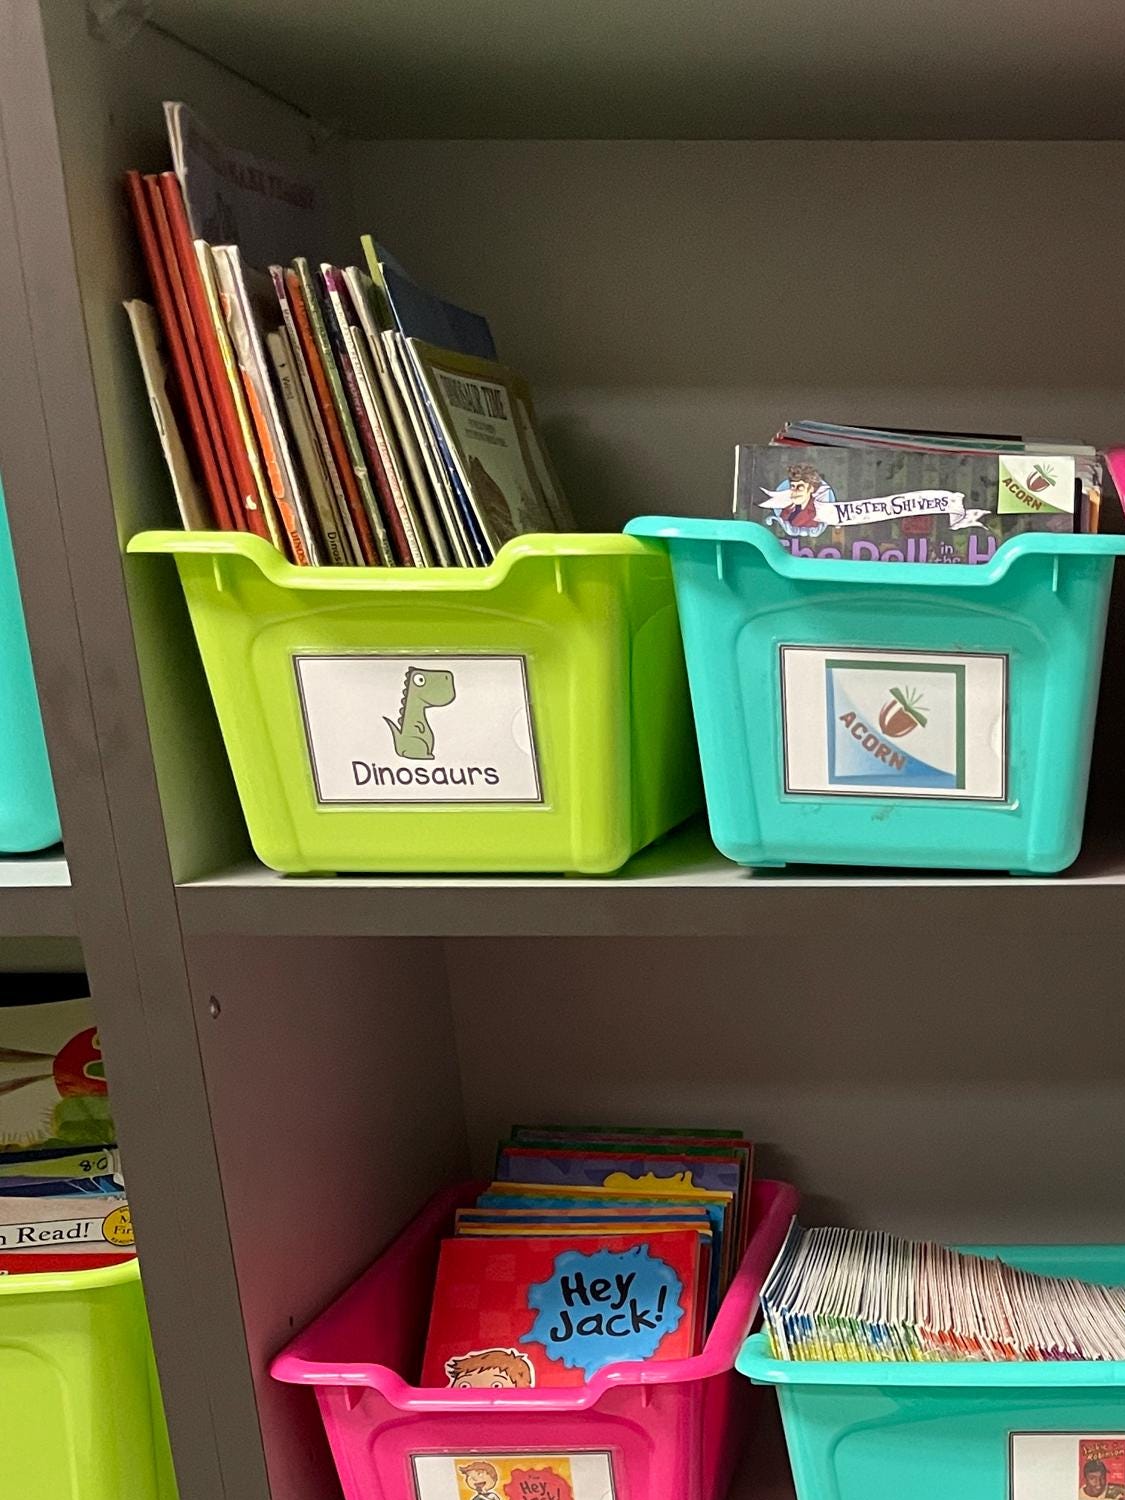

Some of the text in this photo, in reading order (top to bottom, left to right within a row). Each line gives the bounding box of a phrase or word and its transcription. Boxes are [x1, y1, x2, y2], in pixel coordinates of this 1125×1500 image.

[1002, 476, 1042, 511] ACORN
[834, 496, 949, 524] MISTER SHIVERS
[839, 711, 906, 770] ACORN
[352, 760, 500, 786] Dinosaurs
[16, 1222, 90, 1245] Read!
[560, 1271, 636, 1310] Hey
[550, 1285, 668, 1343] Jack!
[1087, 1450, 1125, 1461] Robinson
[520, 1481, 549, 1497] Hey
